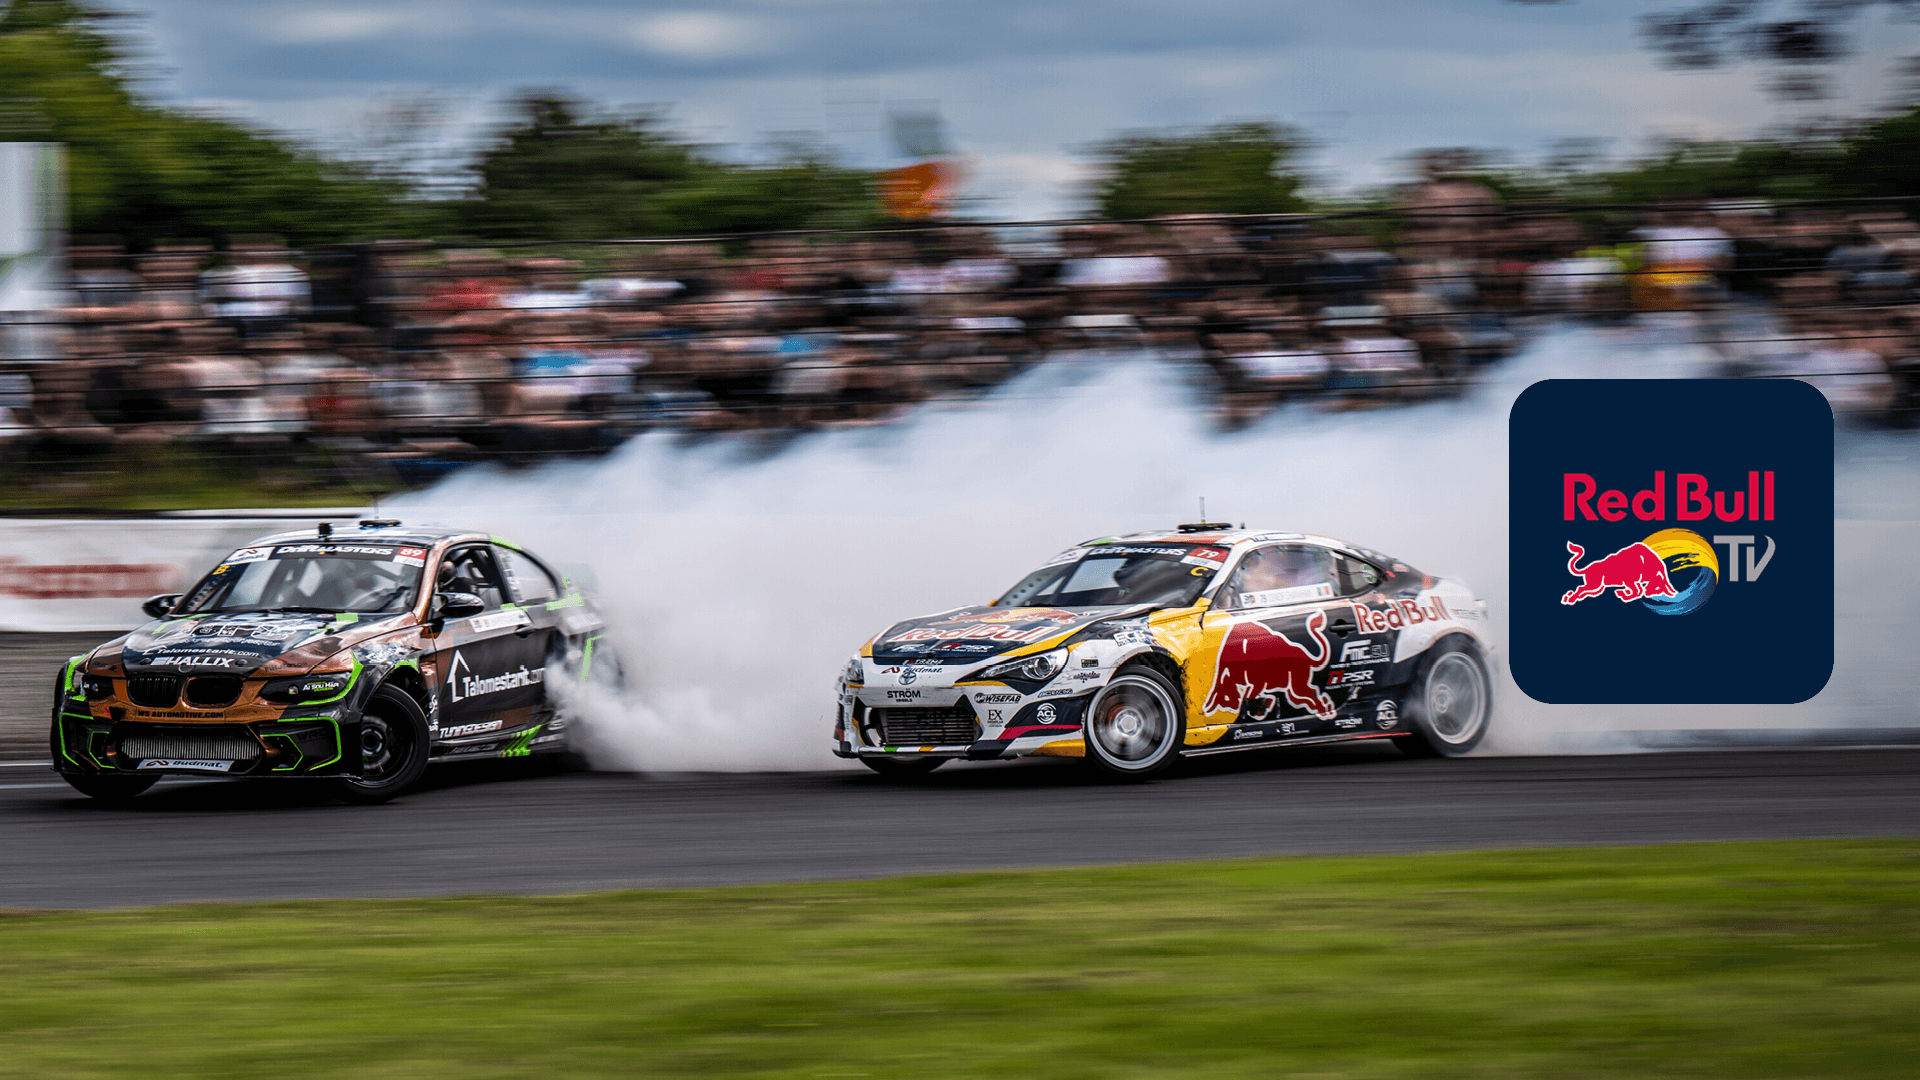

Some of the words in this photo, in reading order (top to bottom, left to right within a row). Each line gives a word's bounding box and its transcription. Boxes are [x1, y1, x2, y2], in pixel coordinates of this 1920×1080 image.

[400, 548, 424, 557] 89
[1197, 549, 1219, 559] 79
[1190, 566, 1209, 577] C
[1354, 602, 1405, 632] Red
[1400, 596, 1453, 625] Bull
[891, 624, 986, 642] Red
[961, 624, 1058, 642] Bull
[886, 688, 921, 699] STRÖM
[985, 694, 1021, 702] WISEFAB
[151, 711, 224, 719] AUTOMOTIVE.COM
[987, 709, 1003, 720] EX
[172, 760, 223, 768] Budmat.
